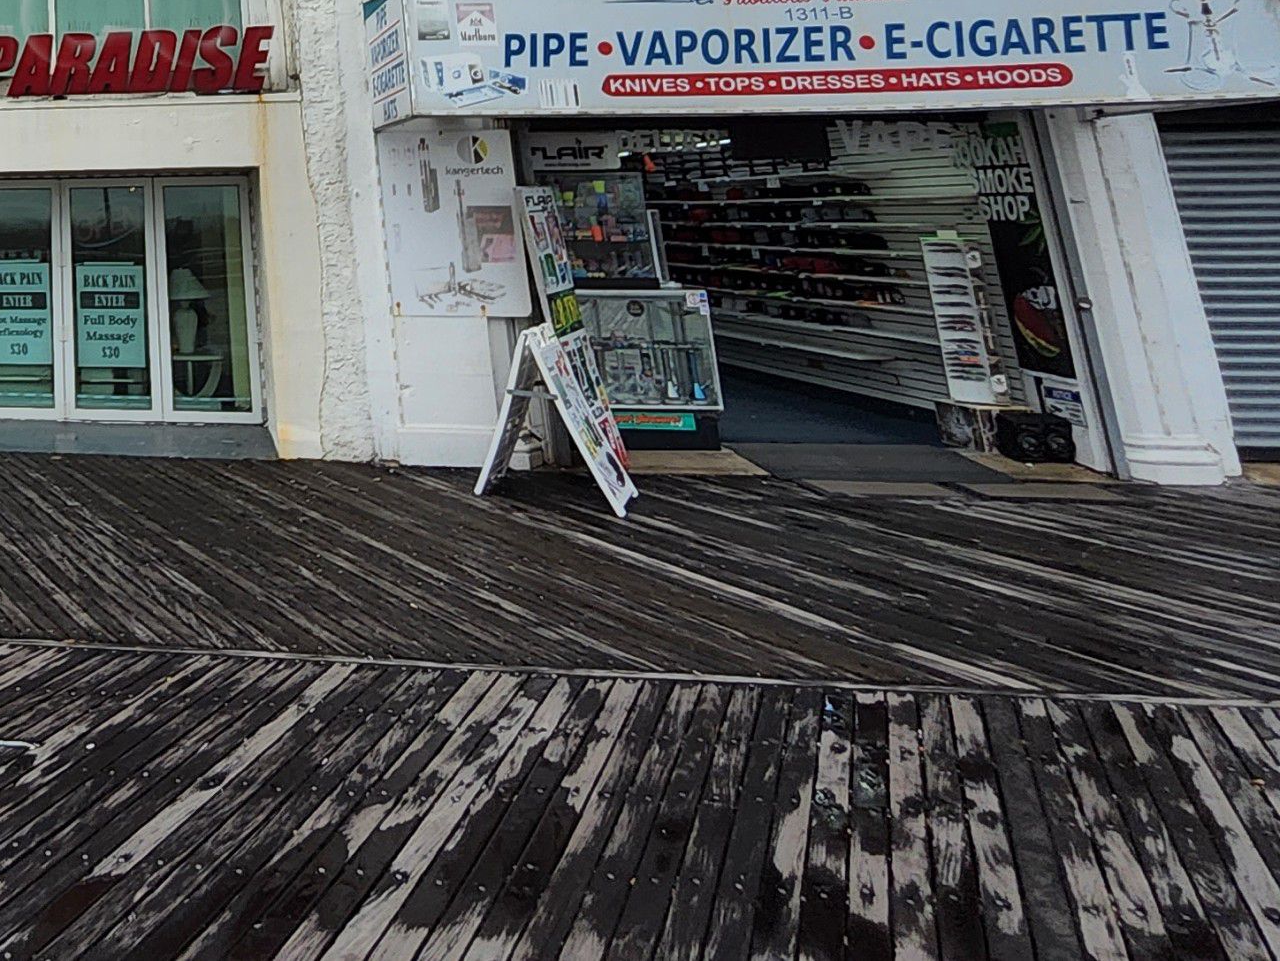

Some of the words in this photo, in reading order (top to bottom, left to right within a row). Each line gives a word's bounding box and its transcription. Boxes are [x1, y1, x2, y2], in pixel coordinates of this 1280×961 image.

[785, 5, 854, 21] 1311-B
[504, 33, 589, 67] PIPE
[616, 25, 857, 66] VAPORIZER
[884, 12, 1170, 60] E-CIGARETTE
[609, 77, 690, 94] KNIVES
[704, 75, 765, 92] TOPS
[781, 73, 885, 90] DRESSES
[902, 71, 962, 87] HATS
[977, 67, 1063, 85] HOODS
[445, 165, 504, 177] kangertech
[972, 166, 1035, 195] SMOKE
[978, 194, 1031, 222] SHOP
[19, 271, 43, 285] PAIN
[83, 274, 109, 288] BACK
[111, 274, 136, 288] PAIN
[2, 294, 33, 307] ENTER
[94, 294, 125, 307] ENTER
[10, 316, 47, 325] Massage
[83, 315, 106, 325] Full
[108, 315, 138, 328] Body
[85, 331, 136, 344] Massage
